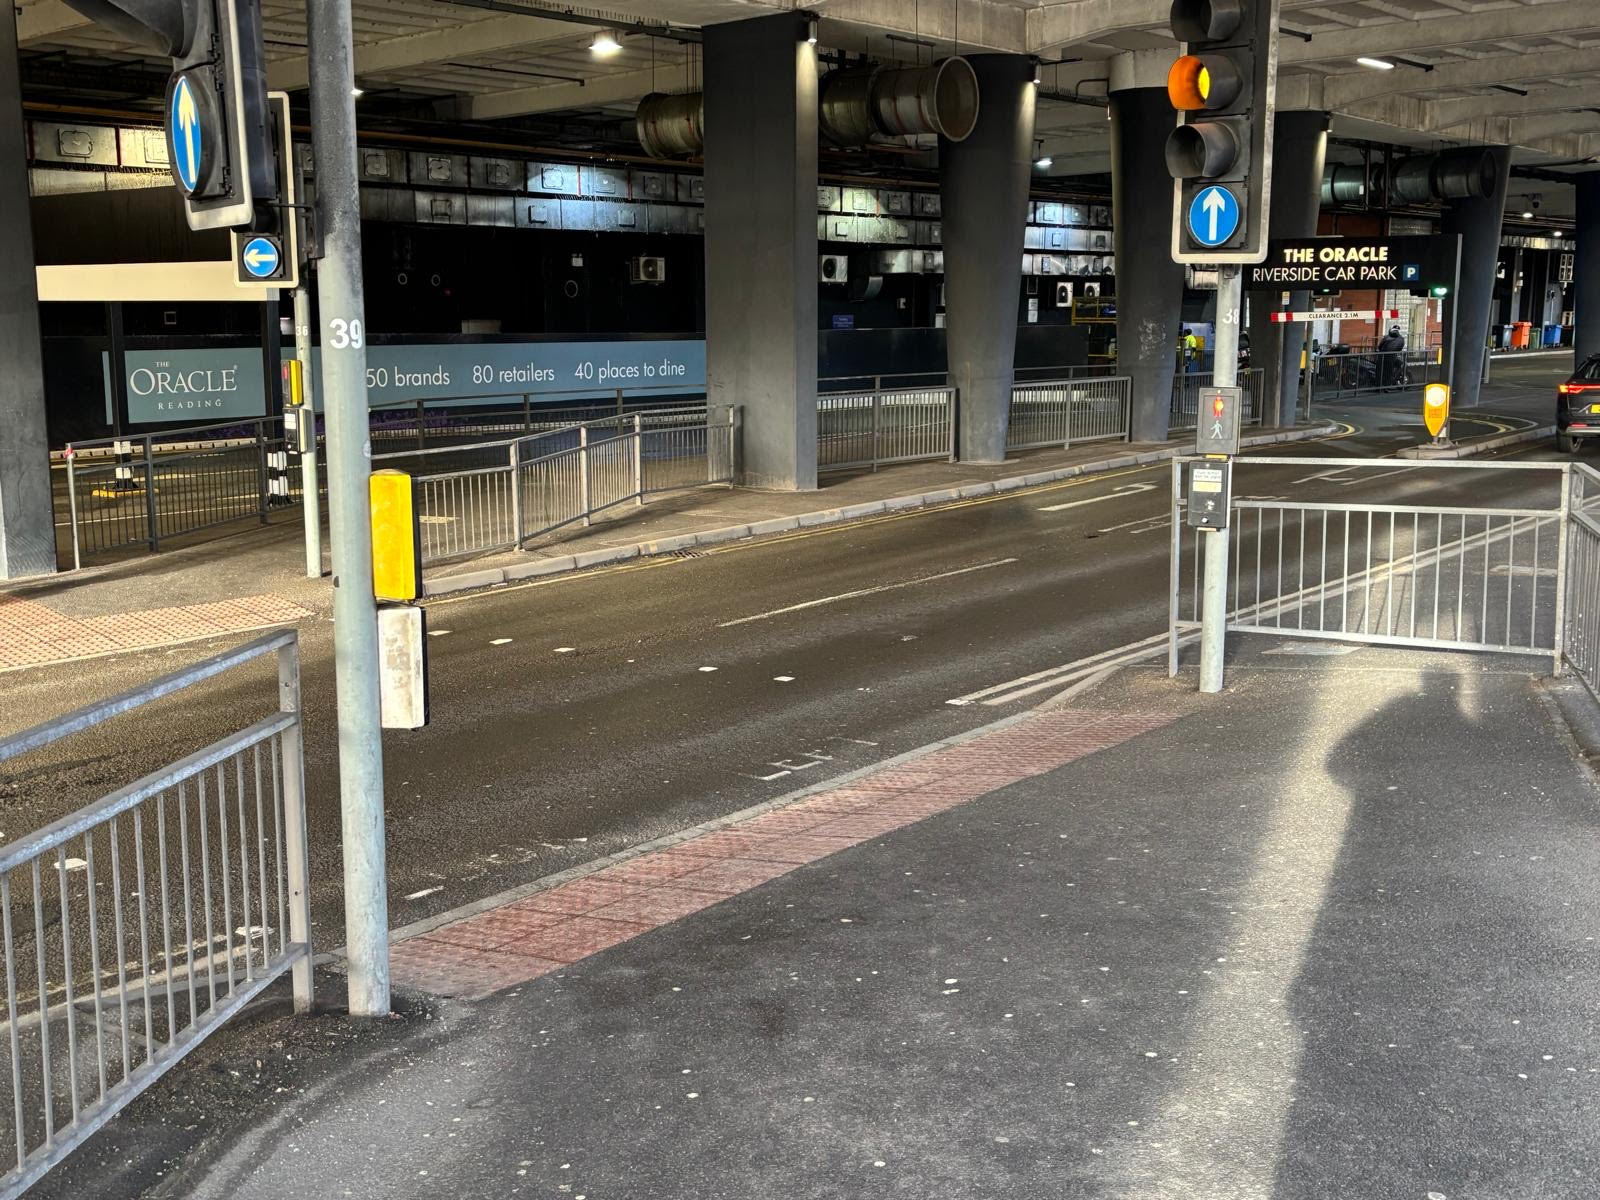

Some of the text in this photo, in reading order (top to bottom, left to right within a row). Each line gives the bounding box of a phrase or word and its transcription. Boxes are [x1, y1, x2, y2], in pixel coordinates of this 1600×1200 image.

[1284, 246, 1389, 263] THE ORACLE
[1252, 265, 1397, 282] RIVERSIDE CAR PARK
[1406, 266, 1416, 279] P
[295, 325, 309, 337] 36
[329, 318, 363, 349] 39
[394, 364, 450, 387] brands
[472, 364, 493, 384] 80
[499, 361, 555, 383] retailers
[574, 361, 594, 380] 40
[598, 359, 640, 385] places
[643, 362, 655, 377] to
[658, 358, 686, 377] dine
[129, 367, 237, 396] ORACLE
[157, 399, 222, 410] READING
